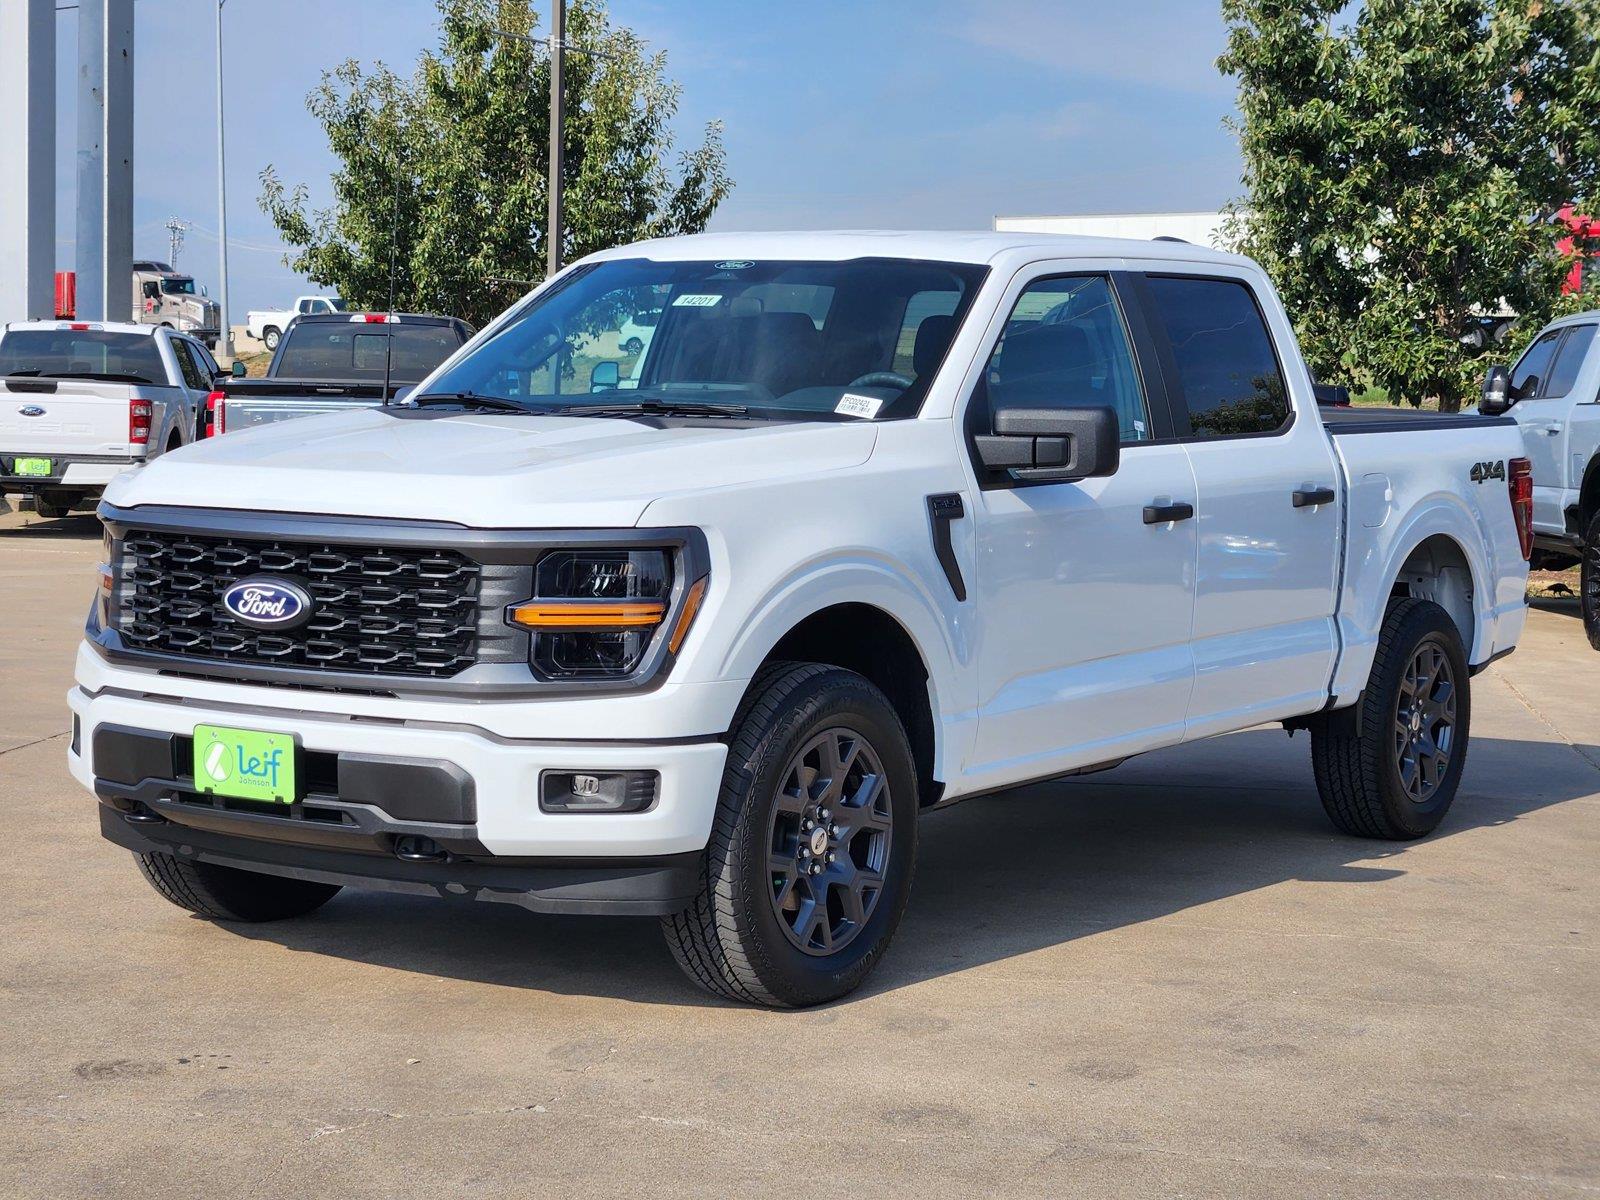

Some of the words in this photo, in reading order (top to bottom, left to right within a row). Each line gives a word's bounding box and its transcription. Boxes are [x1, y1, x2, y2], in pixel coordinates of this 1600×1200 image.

[681, 296, 714, 305] 14201
[238, 588, 287, 617] Ford
[237, 744, 283, 787] leif
[239, 777, 270, 787] Johnson
